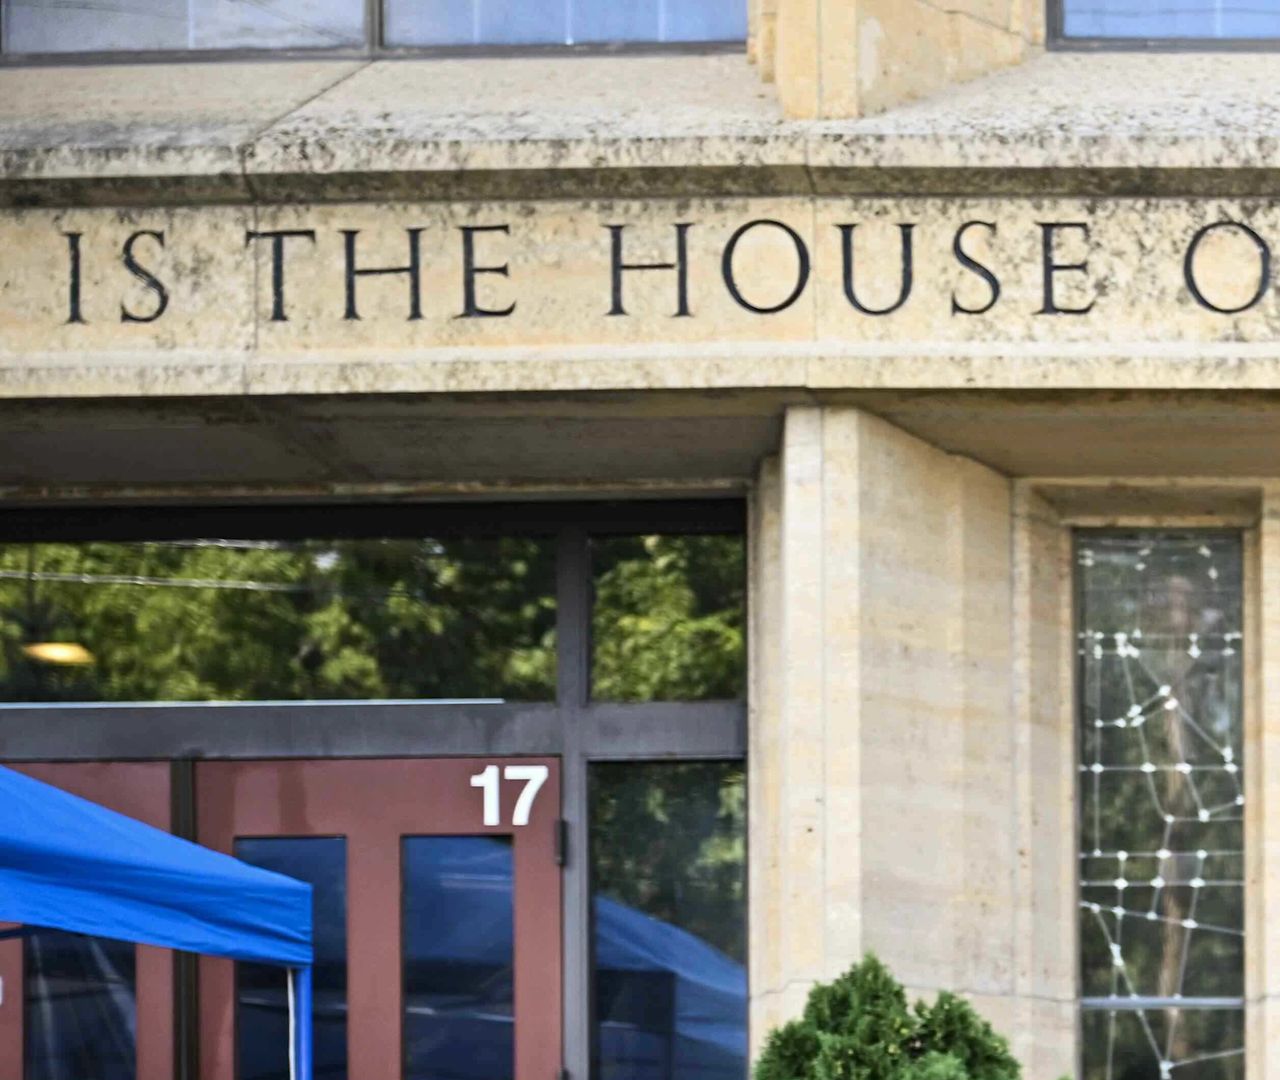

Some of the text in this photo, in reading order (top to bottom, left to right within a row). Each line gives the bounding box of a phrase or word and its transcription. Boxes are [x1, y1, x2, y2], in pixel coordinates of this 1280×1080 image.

[64, 229, 169, 324] IS
[246, 223, 518, 323] THE
[606, 219, 1099, 317] HOUSE
[470, 764, 549, 826] 17
